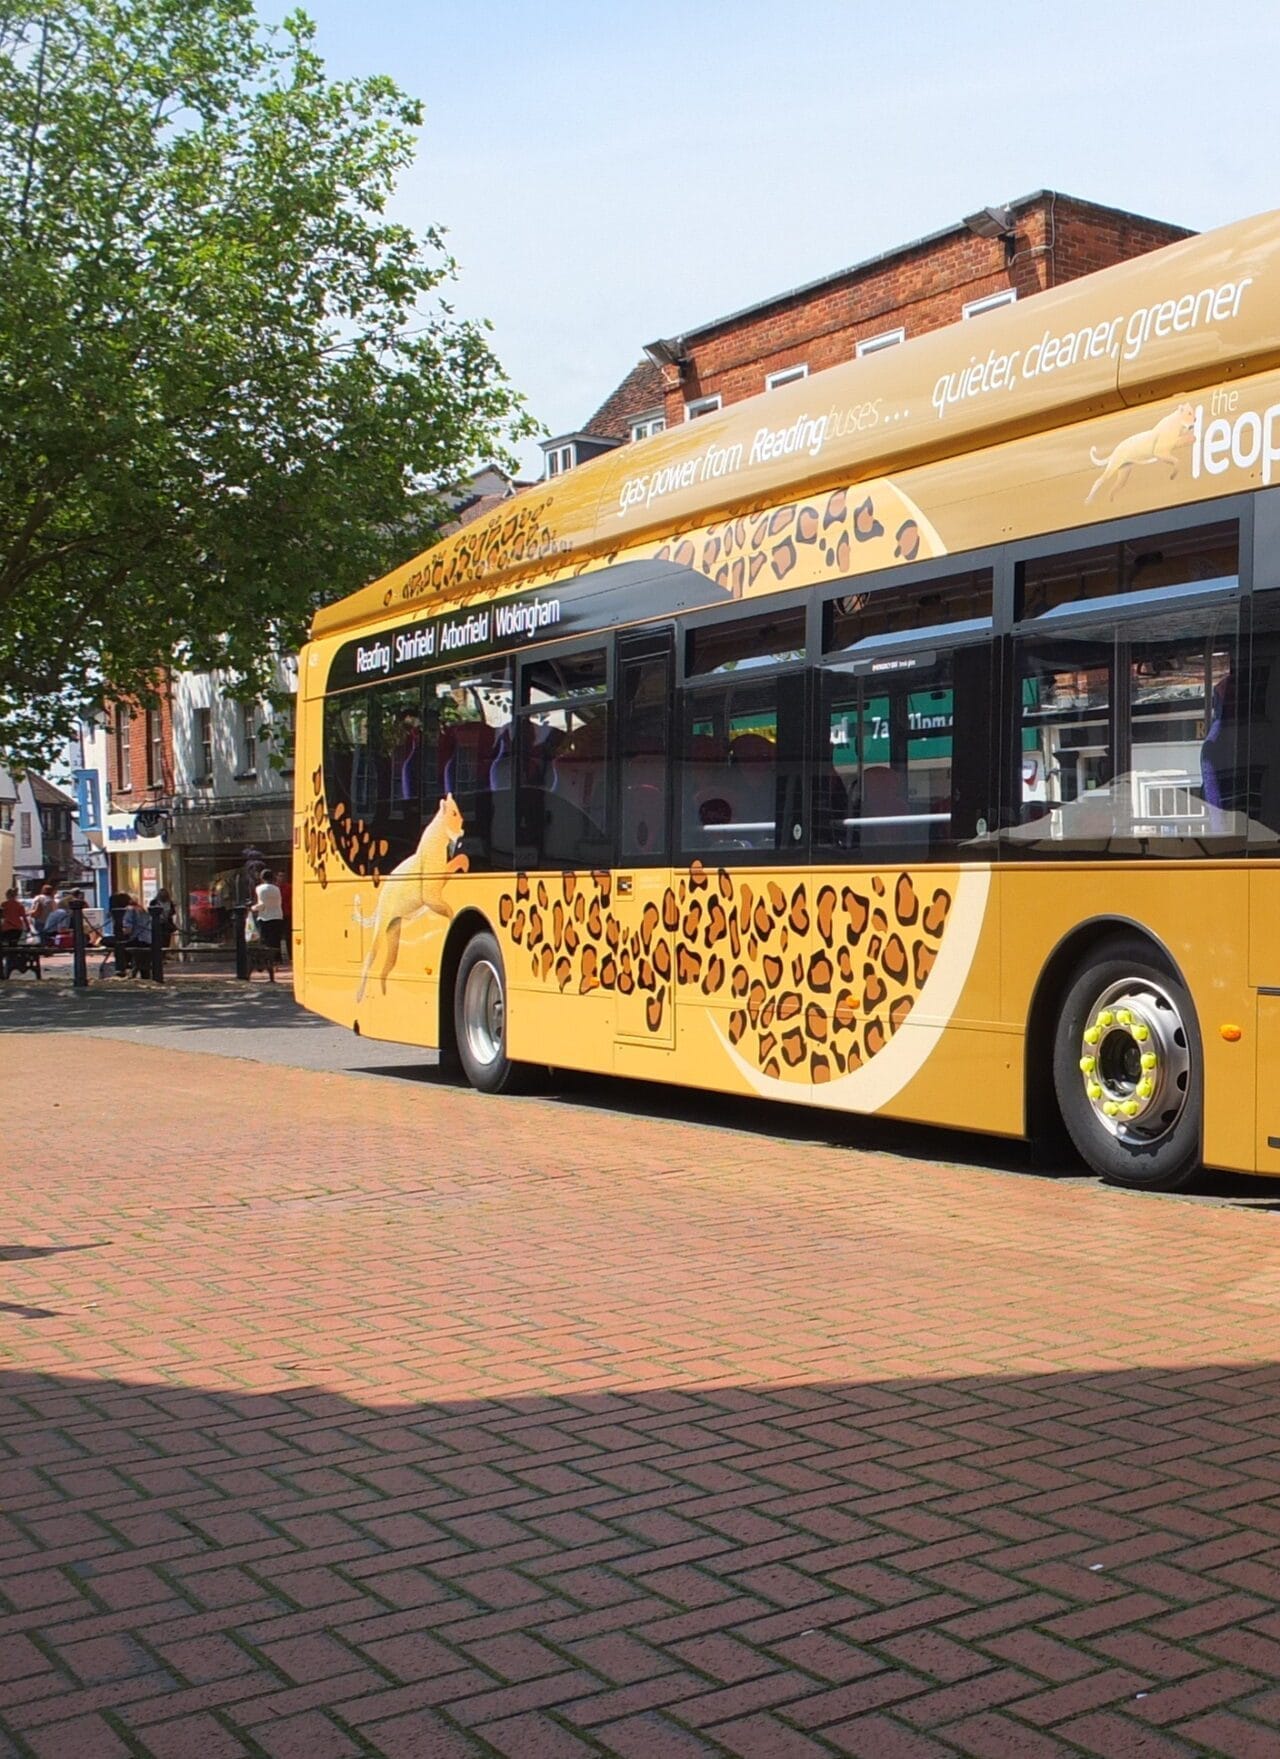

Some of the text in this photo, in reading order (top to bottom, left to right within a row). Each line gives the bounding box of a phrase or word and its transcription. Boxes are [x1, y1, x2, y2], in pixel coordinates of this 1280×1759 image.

[619, 475, 650, 517] gas
[647, 457, 703, 506] power
[700, 441, 743, 482] from
[931, 349, 1020, 418] quieter,
[1022, 319, 1123, 379] cleaner,
[1123, 277, 1253, 359] greener
[1210, 387, 1239, 418] the
[356, 598, 560, 674] Reading Shinfield Arborfield Wokingham
